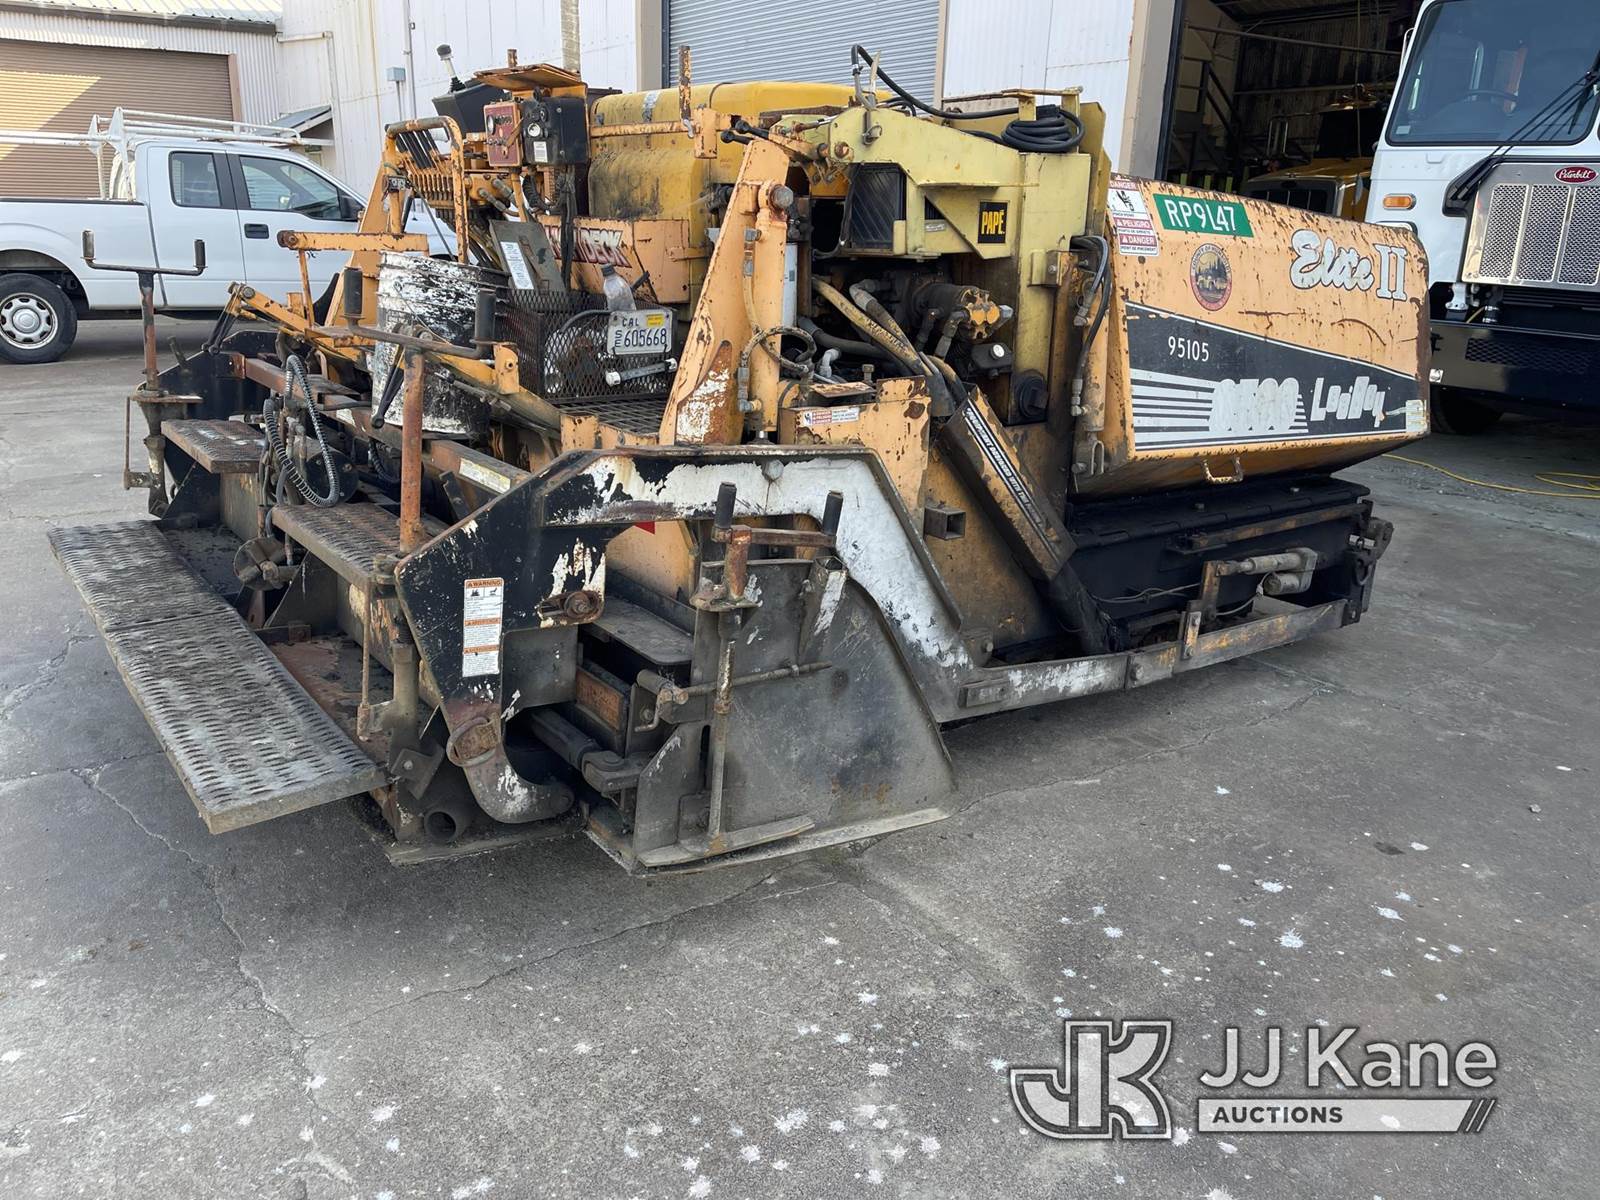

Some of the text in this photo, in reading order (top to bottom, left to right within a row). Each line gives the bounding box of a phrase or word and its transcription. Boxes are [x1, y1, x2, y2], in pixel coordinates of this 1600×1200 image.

[1558, 169, 1595, 179] Peterbilt
[1163, 199, 1236, 232] RP9L47
[1128, 237, 1155, 246] DANGER
[622, 317, 639, 327] CAL
[624, 328, 667, 347] 605668
[1168, 336, 1209, 361] 95105
